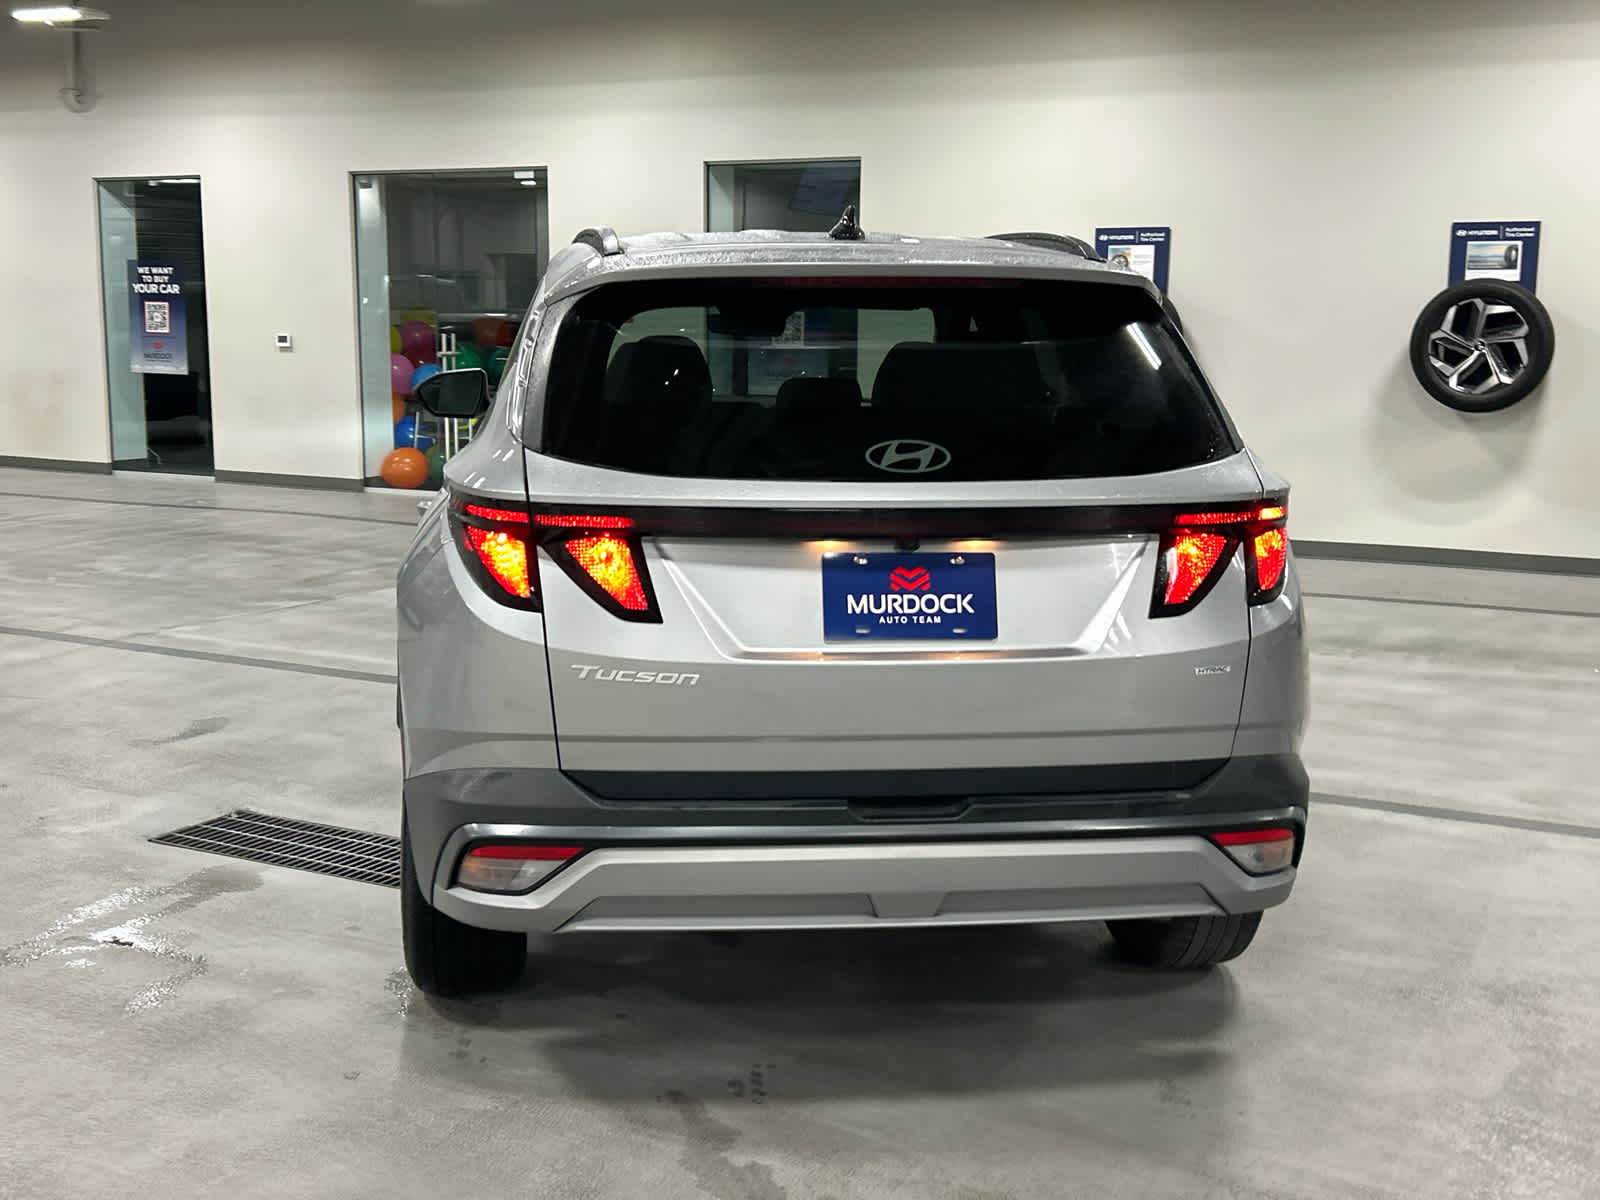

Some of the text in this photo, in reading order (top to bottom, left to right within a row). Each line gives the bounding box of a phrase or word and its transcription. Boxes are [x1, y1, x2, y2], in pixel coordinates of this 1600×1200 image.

[153, 275, 169, 283] BUY
[132, 283, 181, 294] YOUR CAR
[847, 593, 975, 614] MURDOCK
[879, 615, 942, 624] AUTO TEAM
